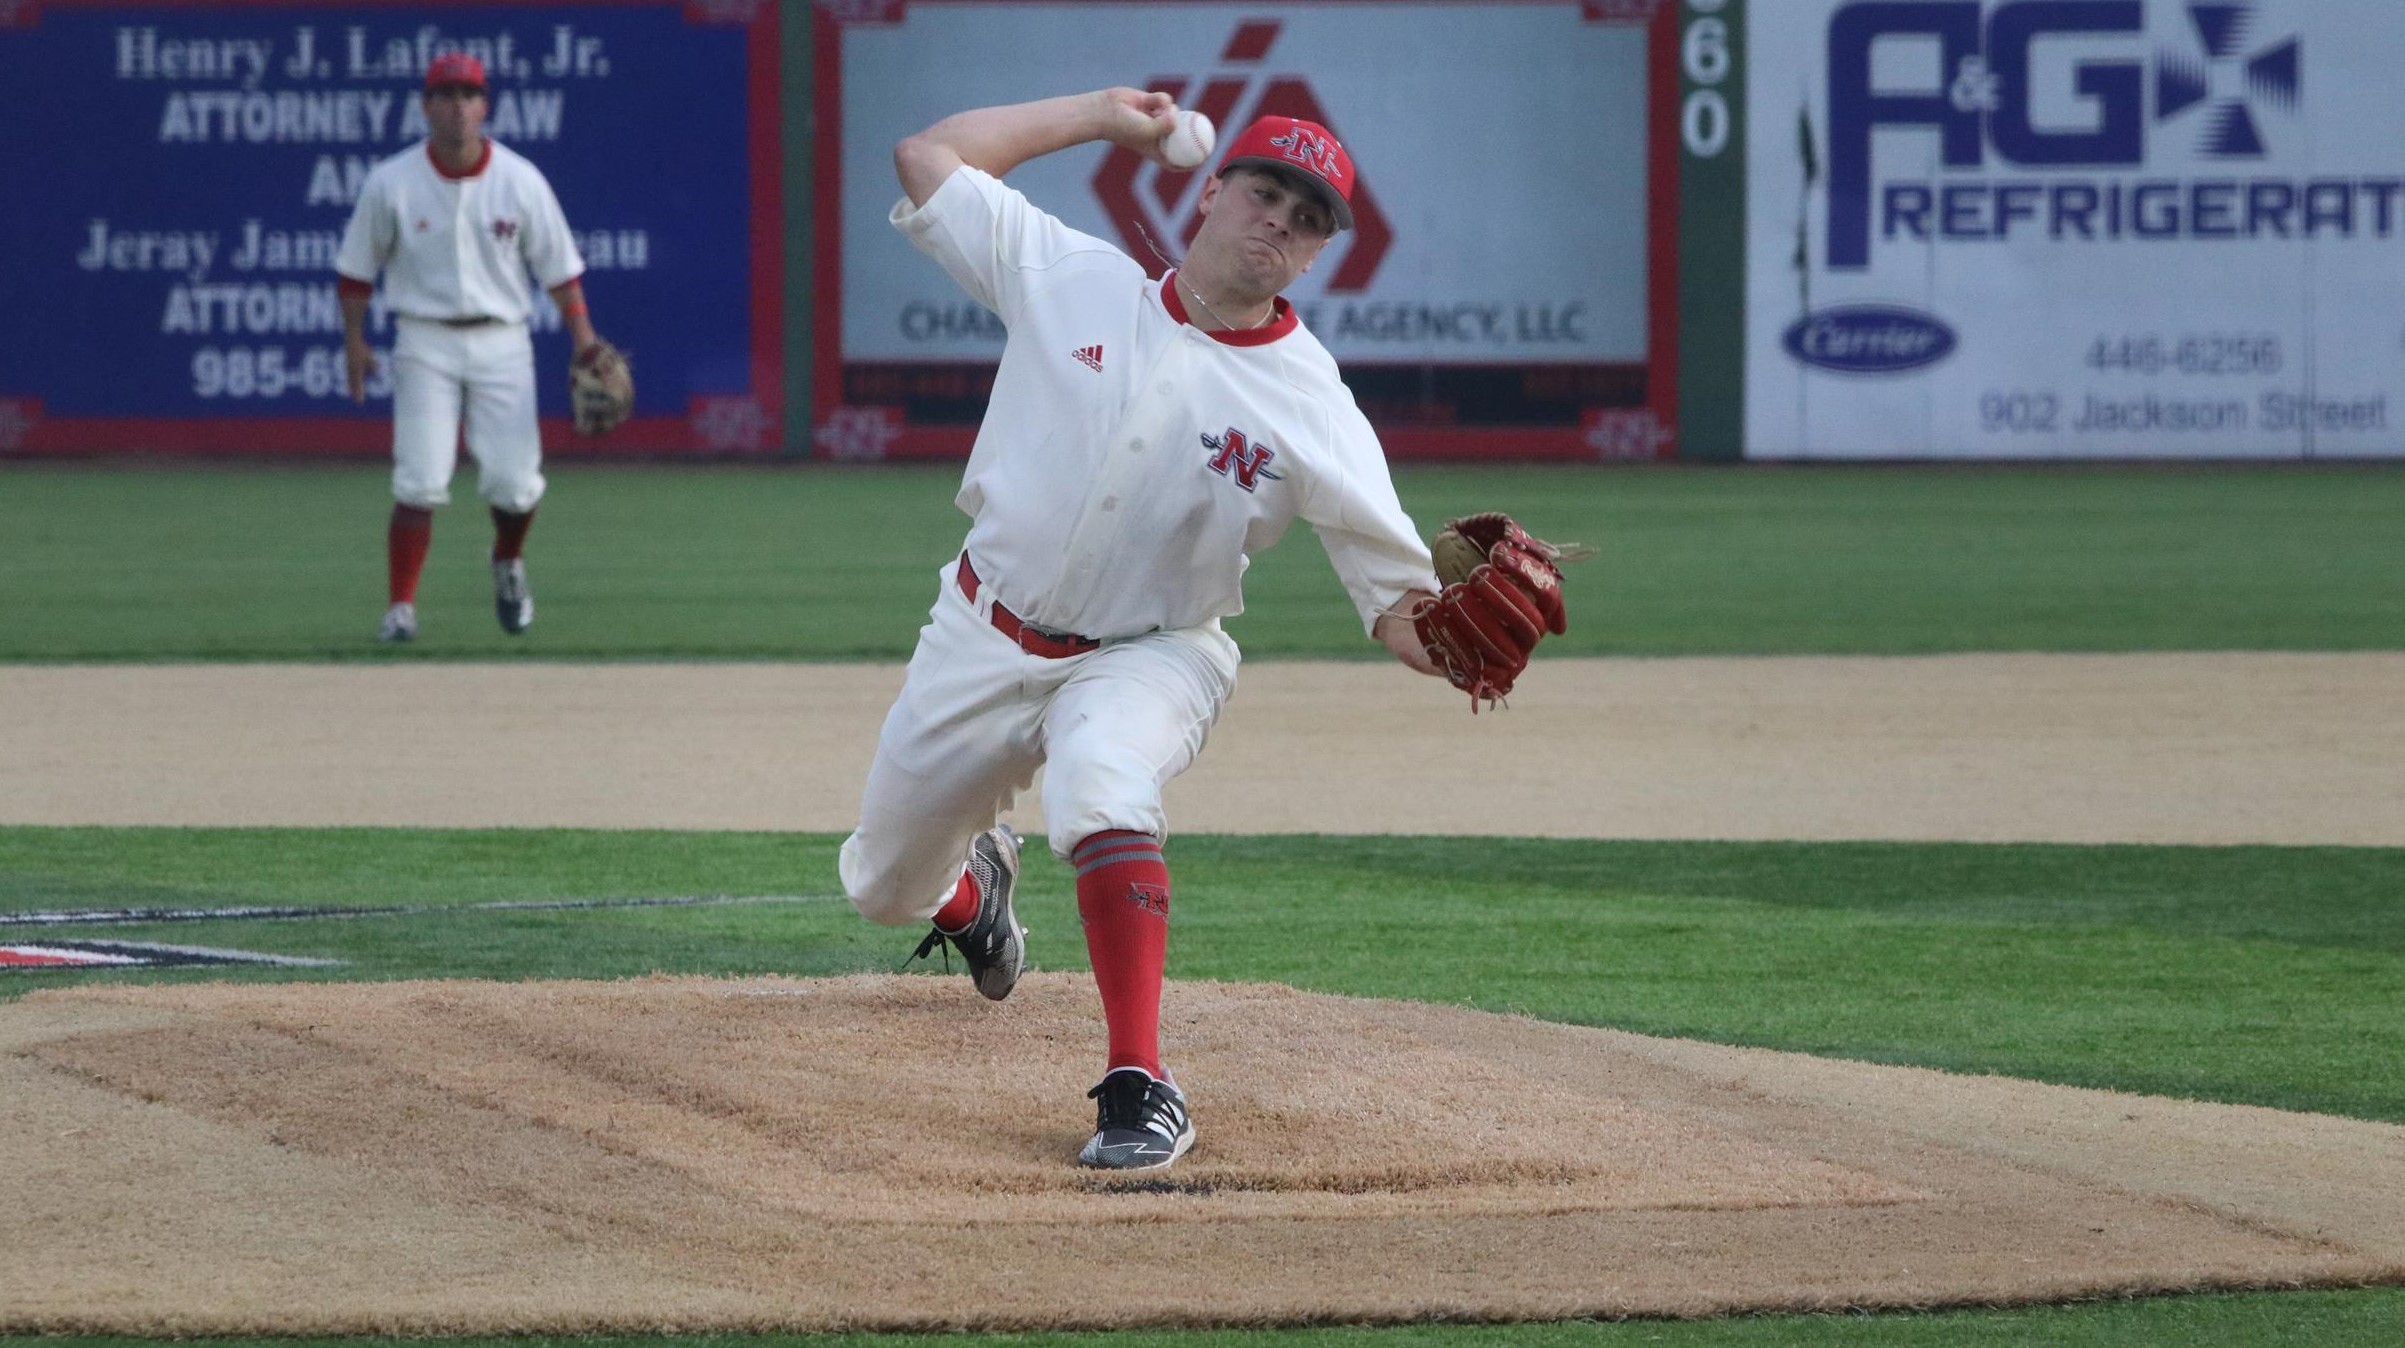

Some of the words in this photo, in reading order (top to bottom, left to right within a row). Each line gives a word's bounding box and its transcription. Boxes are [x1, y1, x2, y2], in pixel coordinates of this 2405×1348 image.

[115, 26, 273, 91] Henry
[285, 26, 332, 79] J.
[543, 26, 611, 78] Jr.
[1682, 0, 1731, 159] 60
[159, 91, 393, 142] ATTORNEY
[480, 91, 564, 141] AW
[1283, 126, 1338, 180] N
[1882, 181, 2405, 240] REFRIGERAT
[77, 220, 220, 280] Jeray
[1333, 303, 1508, 345] AGENCY,
[1516, 303, 1588, 342] LLC
[1071, 349, 1103, 373] adidas
[2084, 334, 2283, 375] 446-6256
[1978, 392, 2058, 433] 902
[2072, 391, 2248, 433] Jackson
[2259, 391, 2389, 433] Street
[1207, 426, 1276, 494] N
